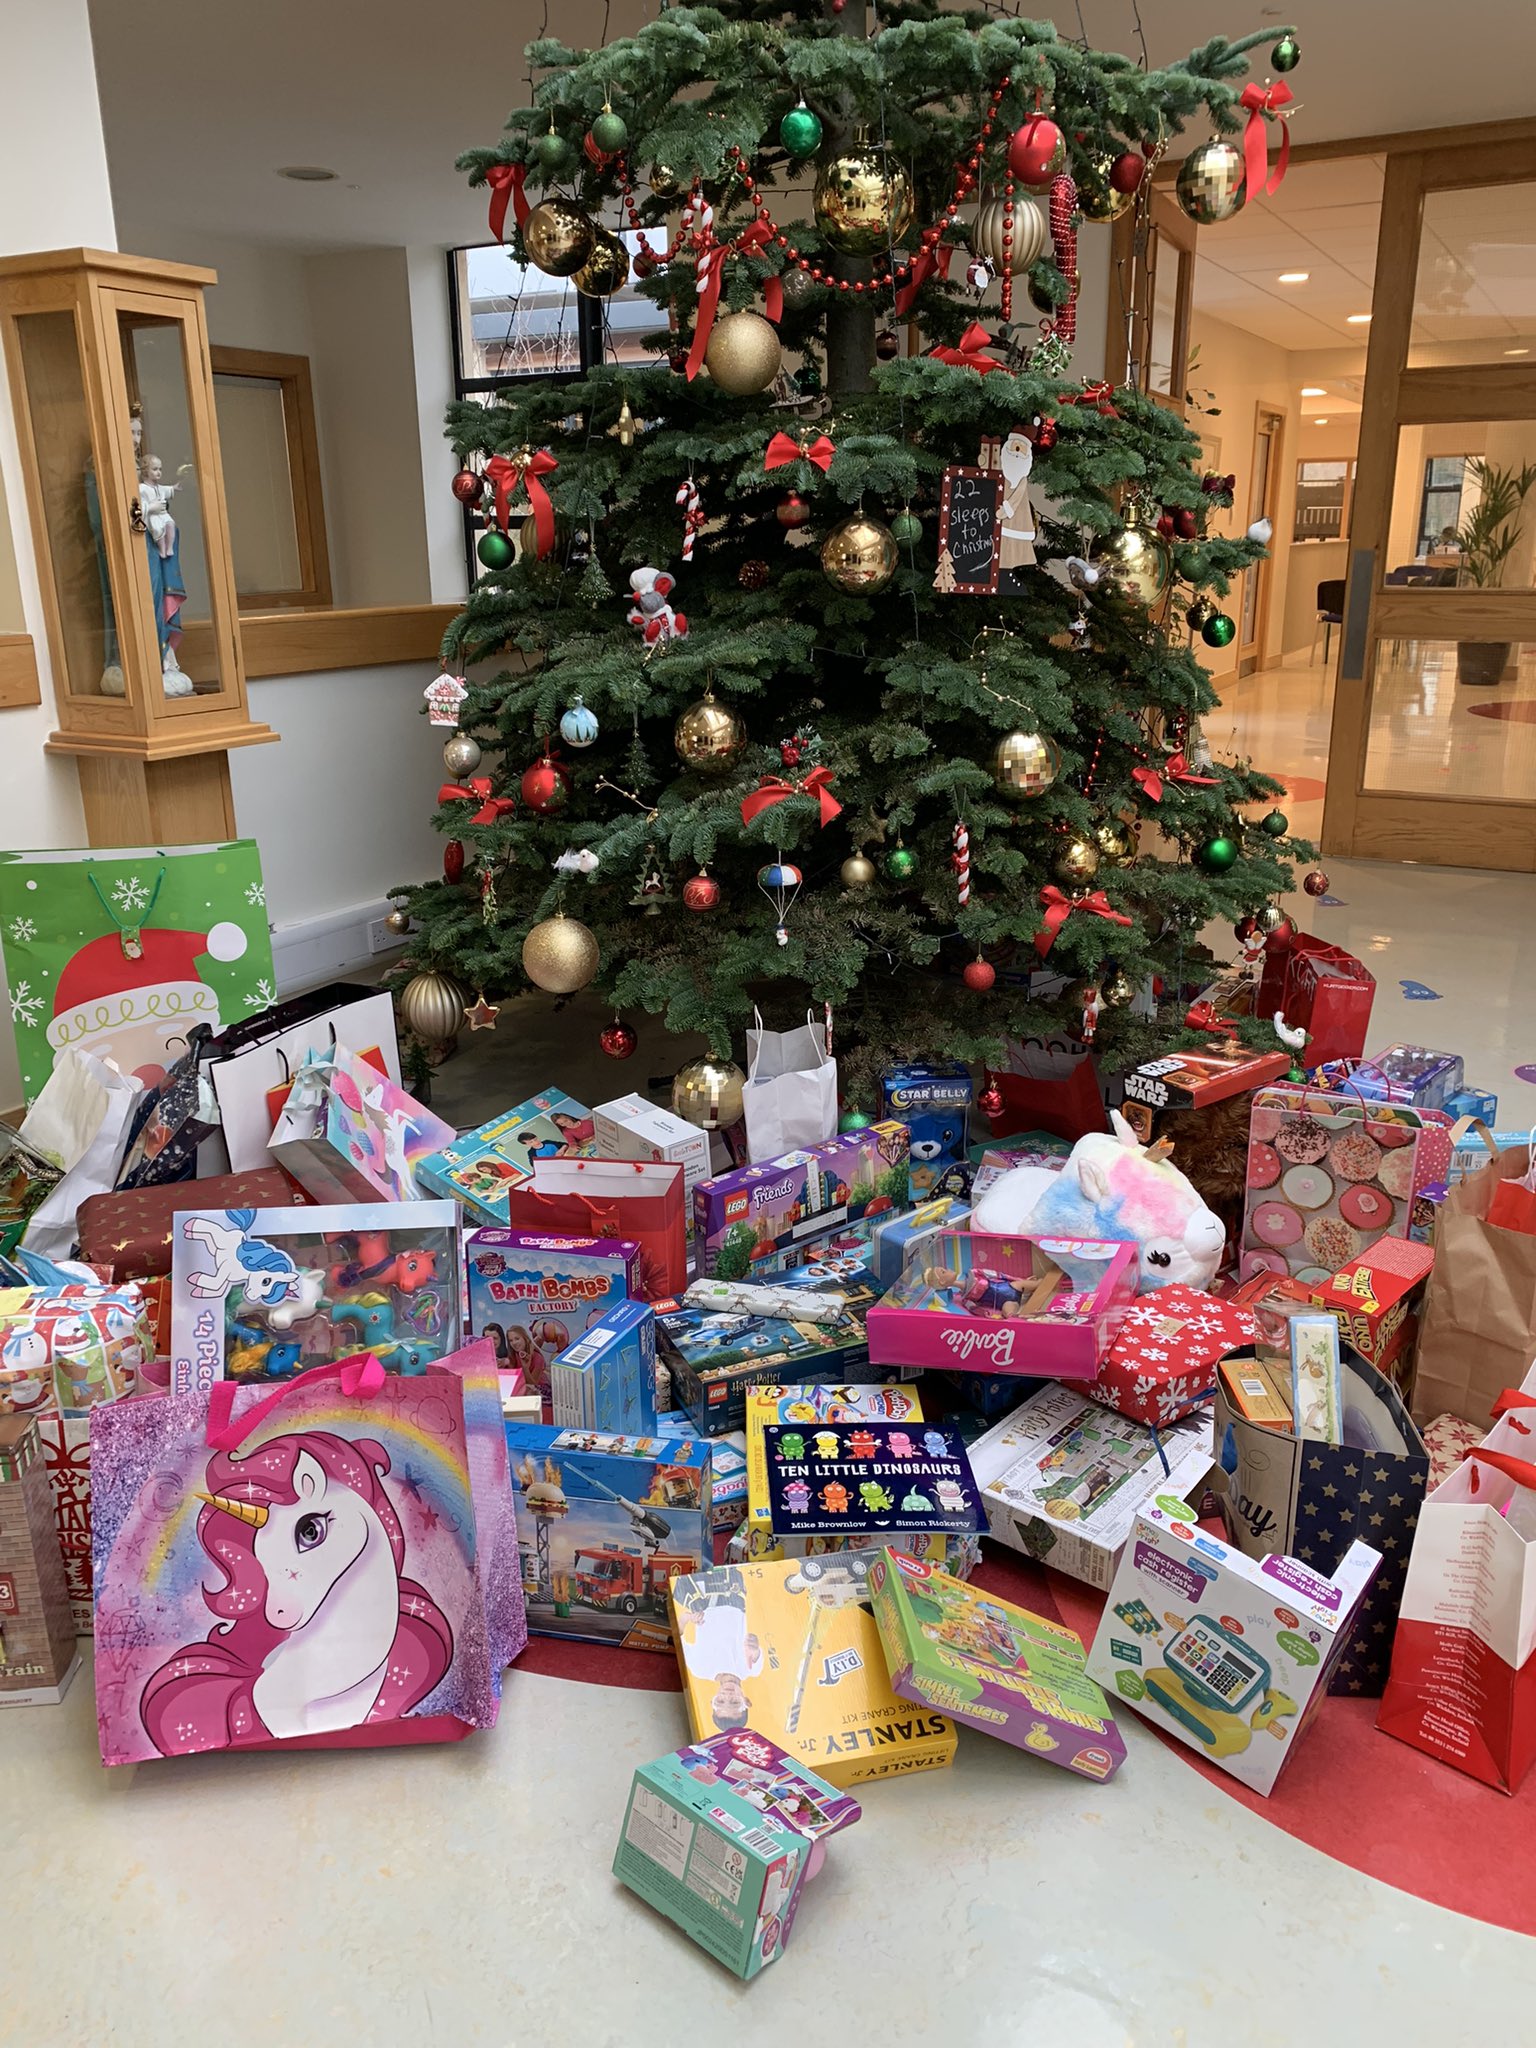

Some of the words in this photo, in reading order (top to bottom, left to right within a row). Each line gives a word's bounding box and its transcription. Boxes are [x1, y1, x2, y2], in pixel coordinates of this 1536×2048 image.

[954, 479, 981, 499] 22
[951, 506, 990, 527] sleeps
[961, 524, 977, 538] to
[900, 1089, 930, 1099] STAR
[933, 1089, 969, 1098] BELLY
[1125, 1074, 1169, 1096] STAR
[1125, 1084, 1169, 1107] WARS
[752, 1178, 794, 1210] Friends
[727, 1198, 748, 1215] LEGO
[725, 1228, 739, 1240] 7+
[489, 1282, 539, 1302] BATH
[542, 1276, 610, 1300] BOMBS
[529, 1302, 578, 1313] FACTORY
[656, 1301, 676, 1310] LEGO
[193, 1310, 214, 1337] 14
[1352, 1315, 1374, 1352] UNO
[940, 1327, 1016, 1366] Barbie
[197, 1339, 219, 1392] Piec
[176, 1359, 191, 1395] Einh
[709, 1387, 727, 1398] LEGO
[1011, 1413, 1051, 1441] Harry
[1042, 1391, 1077, 1421] Potter
[777, 1465, 809, 1477] TEN
[815, 1464, 868, 1476] LITTLE
[873, 1463, 962, 1476] DINOSAURS
[791, 1521, 816, 1530] Mike
[818, 1520, 867, 1529] Brownlow
[928, 1520, 971, 1528] Rickerty
[747, 1567, 764, 1580] 5+
[1137, 1554, 1159, 1572] cash
[1160, 1567, 1199, 1594] register
[1147, 1551, 1194, 1583] electronic
[1271, 1558, 1316, 1587] register
[1143, 1567, 1158, 1580] with
[1159, 1577, 1185, 1596] scanner
[1276, 1568, 1327, 1602] electronic
[1316, 1583, 1339, 1600] cash
[1246, 1614, 1272, 1629] play
[832, 1656, 859, 1675] D.I.Y
[910, 1675, 962, 1699] SIMPLE
[841, 1713, 859, 1725] KIT
[862, 1707, 896, 1722] CRANE
[898, 1702, 929, 1715] TING
[927, 1694, 1010, 1726] SENTENCES
[825, 1714, 947, 1756] STANLEY
[865, 1754, 948, 1777] STANLEY
